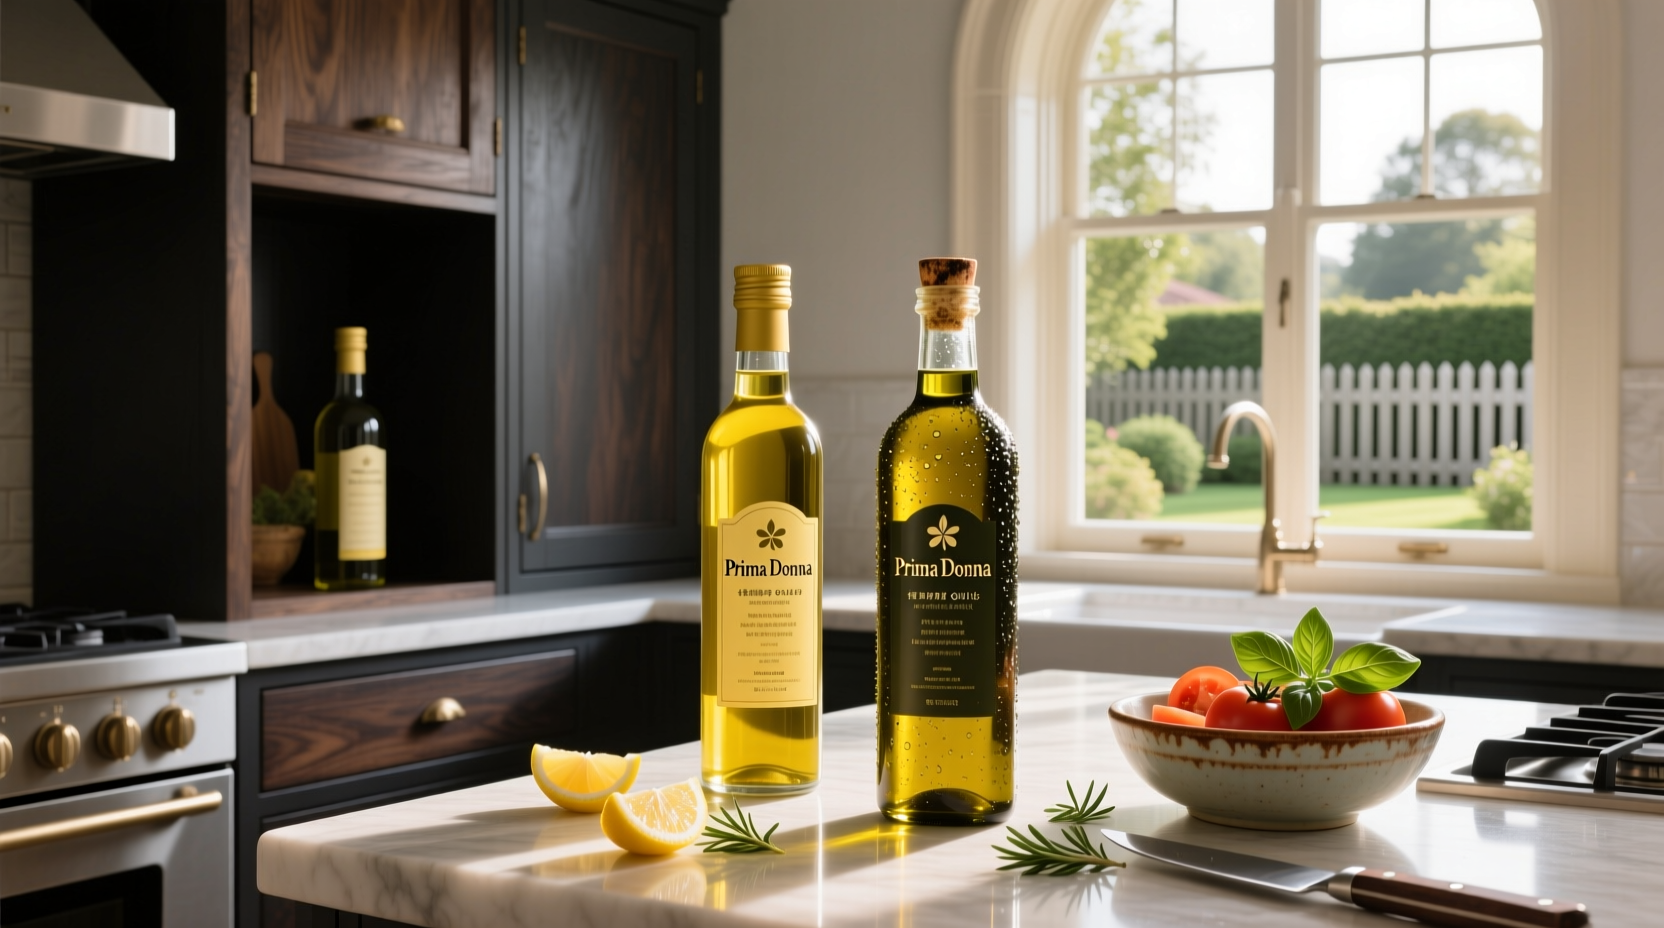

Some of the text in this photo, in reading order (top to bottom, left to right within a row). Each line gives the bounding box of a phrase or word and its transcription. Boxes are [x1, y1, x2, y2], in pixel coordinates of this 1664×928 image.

[725, 559, 812, 577] Prima Donna
[895, 557, 991, 577] Prima Donna
